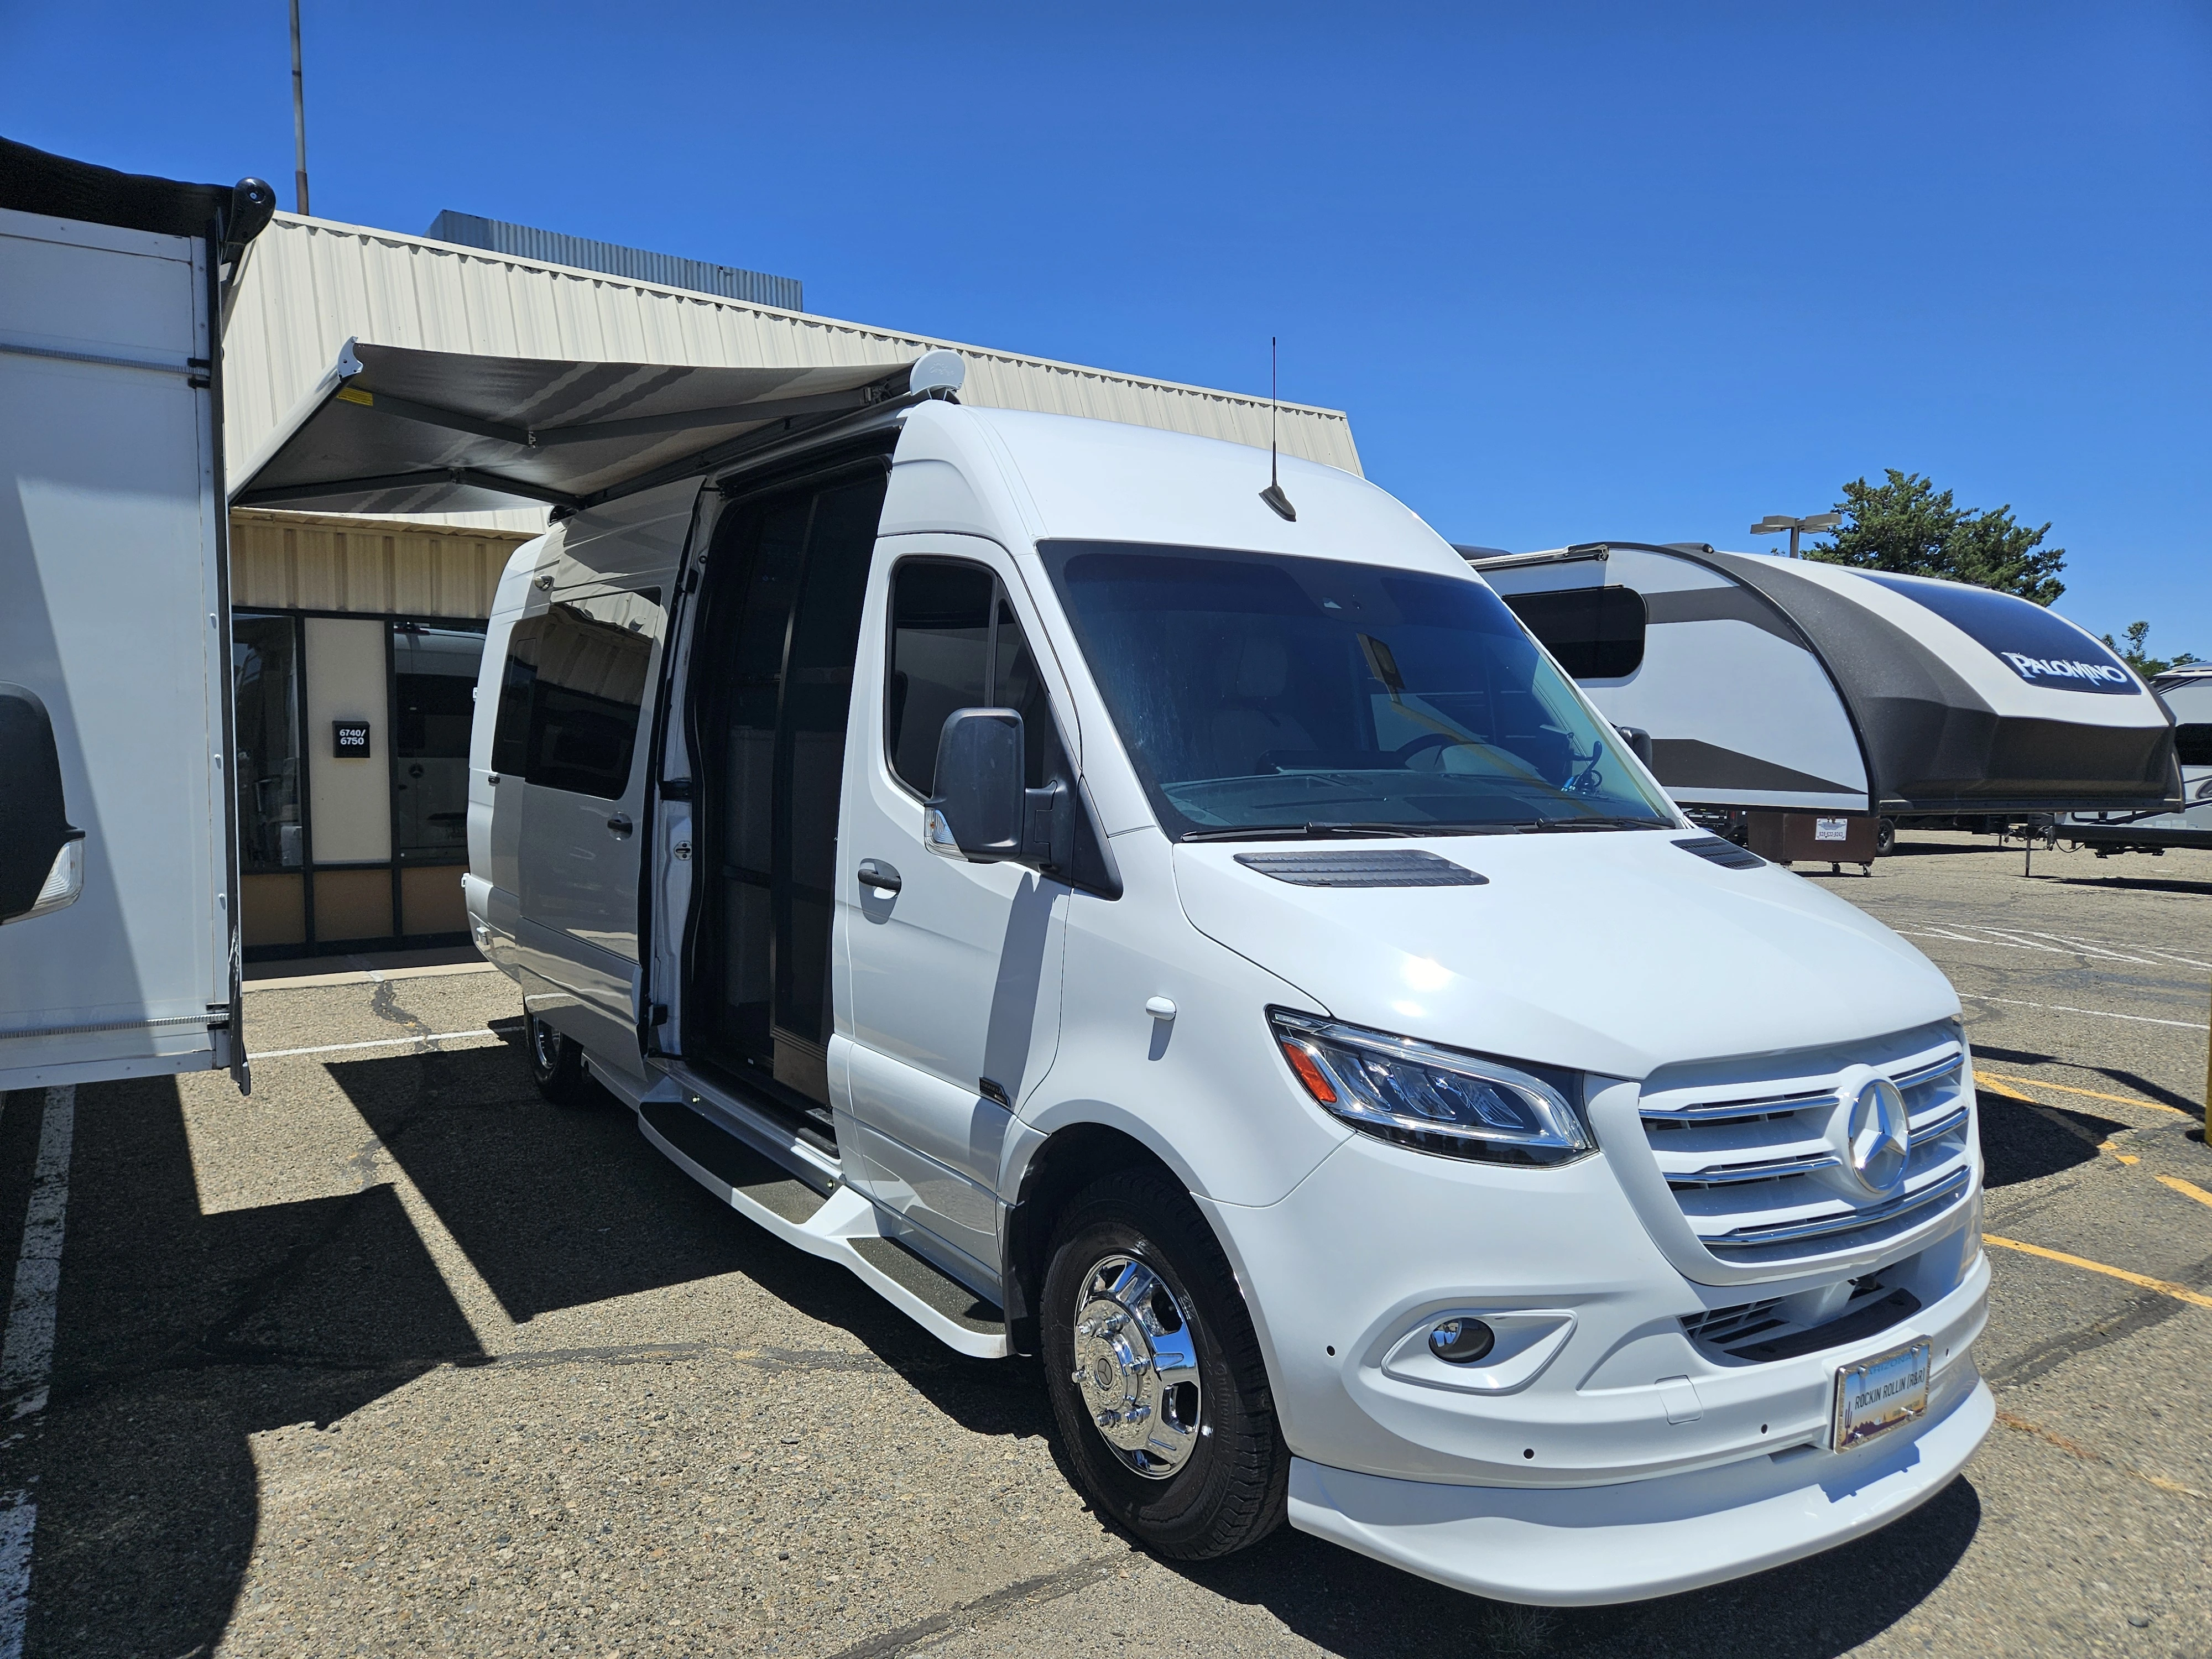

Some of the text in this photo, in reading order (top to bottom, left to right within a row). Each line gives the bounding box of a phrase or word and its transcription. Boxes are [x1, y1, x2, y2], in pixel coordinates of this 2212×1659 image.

[2001, 652, 2128, 686] PALOMINO
[1867, 1353, 1911, 1375] ARIZONA
[1855, 1386, 1881, 1410] ROCKIN
[1883, 1376, 1906, 1399] ROLLIN
[1907, 1367, 1926, 1390] (R&R)
